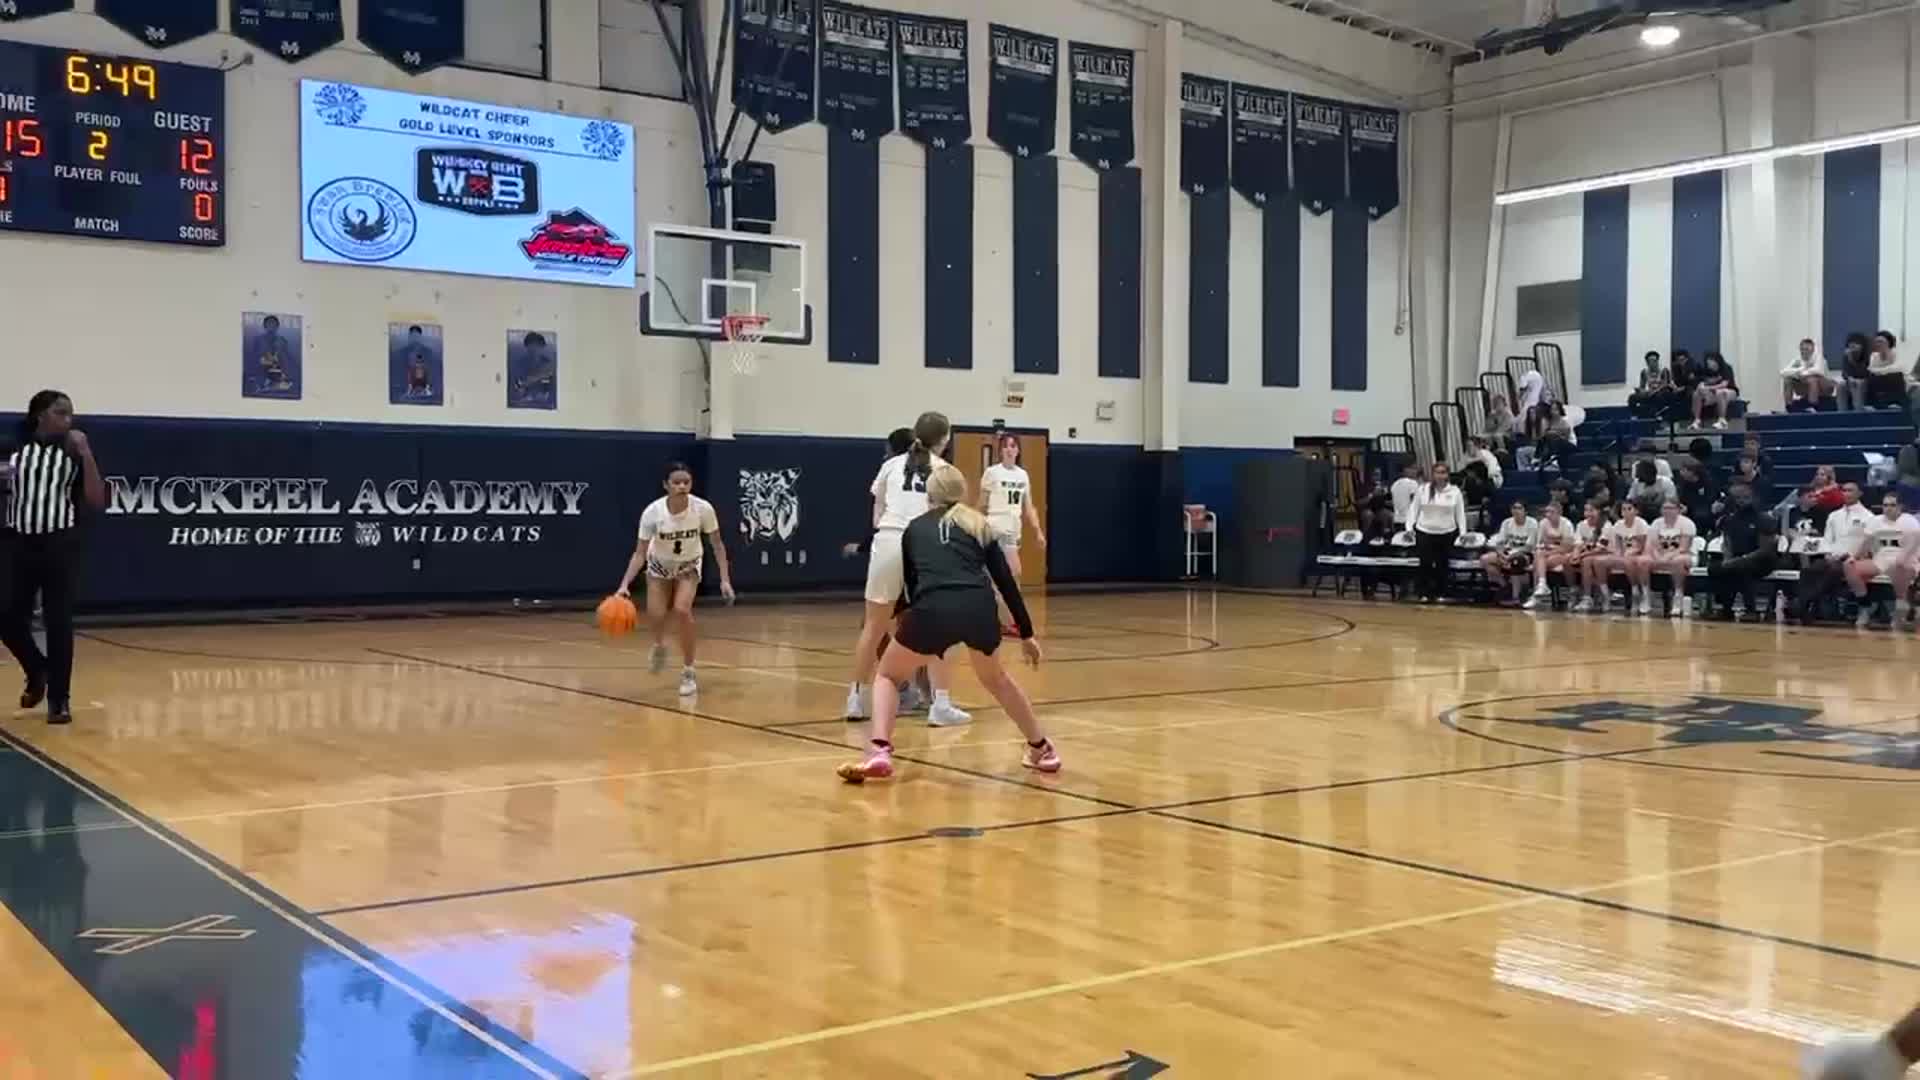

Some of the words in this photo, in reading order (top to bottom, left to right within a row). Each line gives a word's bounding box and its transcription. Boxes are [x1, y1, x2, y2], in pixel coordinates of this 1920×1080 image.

[67, 56, 156, 99] 6:49
[75, 111, 121, 129] PERIOD
[154, 111, 212, 132] GUEST
[420, 101, 480, 120] WILDCAT
[485, 112, 530, 126] CHEER
[5, 119, 41, 157] 15
[88, 131, 109, 160] 2
[399, 118, 434, 132] GOLD
[440, 123, 481, 139] LEVEL
[487, 130, 555, 148] SPONSORS
[180, 138, 213, 174] 12
[54, 165, 103, 181] PLAYER
[110, 171, 141, 185] FOUL
[180, 178, 218, 192] FOULS
[194, 193, 212, 221] 0
[75, 217, 120, 232] MATCH
[179, 226, 219, 240] SCORE
[105, 475, 341, 515] MCKEEL
[348, 478, 590, 515] ACADEMY
[169, 527, 250, 545] HOME
[255, 527, 289, 544] OF
[294, 527, 343, 544] THE
[392, 526, 542, 542] WILDCATS
